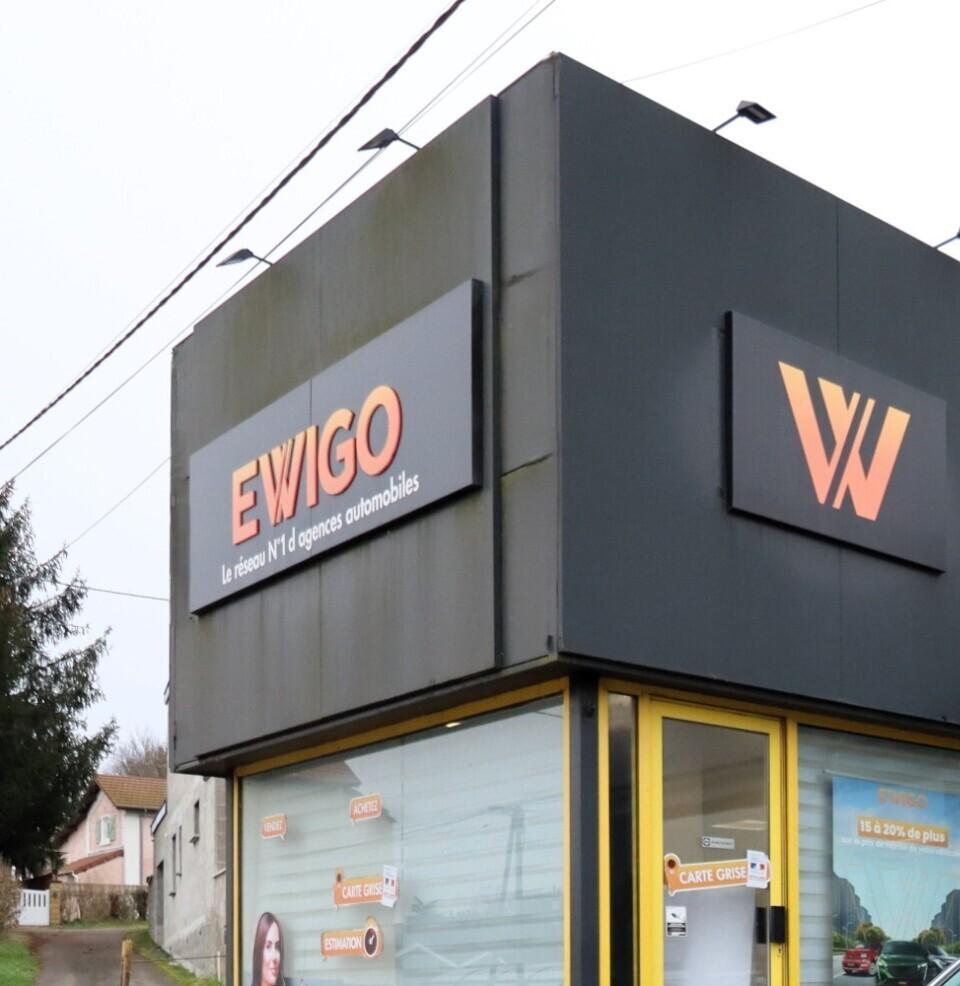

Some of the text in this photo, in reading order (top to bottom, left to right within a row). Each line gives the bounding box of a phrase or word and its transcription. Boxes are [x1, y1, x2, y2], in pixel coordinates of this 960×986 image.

[232, 384, 403, 546] EWIGO
[222, 564, 232, 584] Le
[234, 551, 265, 578] réseau
[345, 472, 419, 524] automobiles
[860, 819, 945, 844] 15 à 20% de plus
[680, 870, 713, 885] CARTE
[716, 866, 747, 881] GRISE
[342, 882, 383, 899] CARTE GRISE
[325, 935, 362, 951] ESTIMATION
